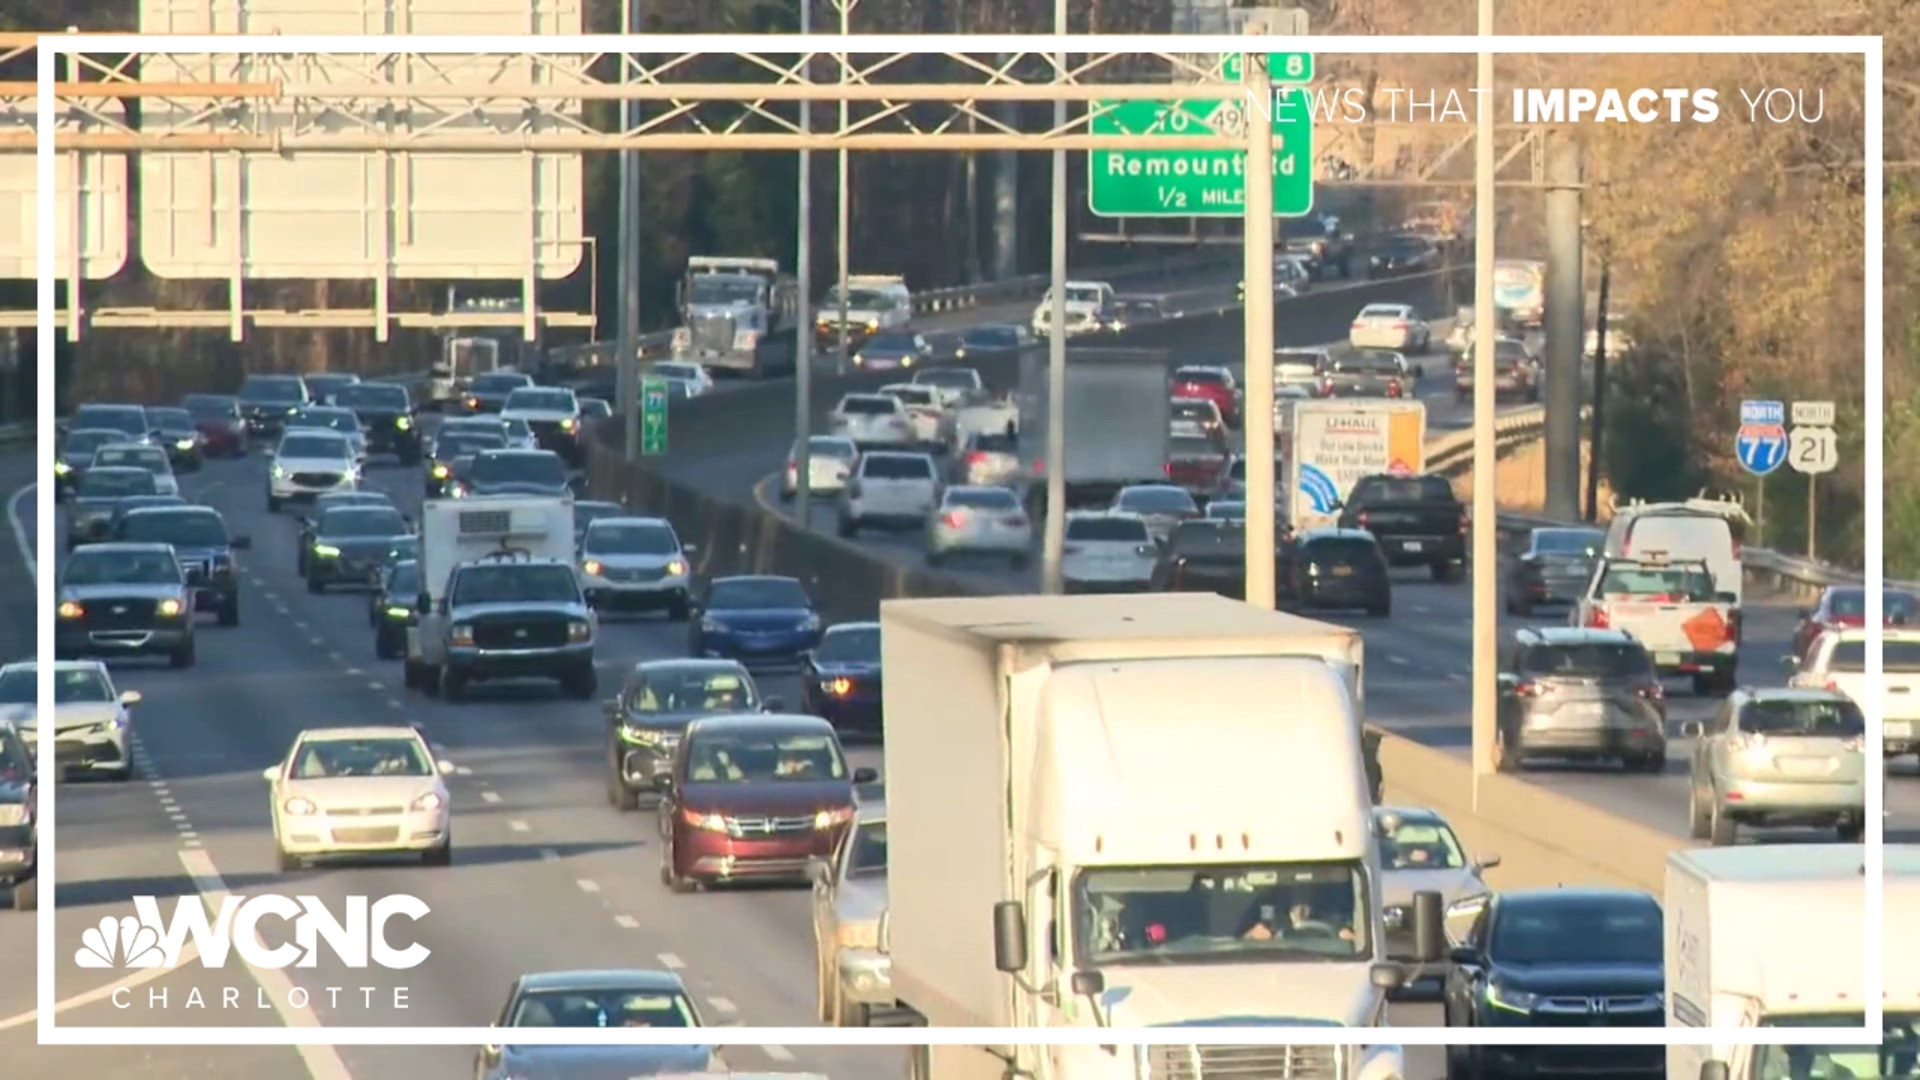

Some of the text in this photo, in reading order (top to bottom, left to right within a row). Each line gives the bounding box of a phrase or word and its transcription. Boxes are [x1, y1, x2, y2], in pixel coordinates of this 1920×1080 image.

[1285, 54, 1304, 76] 8
[1212, 109, 1240, 129] 49
[1107, 153, 1244, 176] Remount
[1157, 185, 1188, 208] 1/2
[1795, 406, 1831, 419] NORTH
[1741, 436, 1781, 465] 77
[1799, 436, 1825, 463] 21
